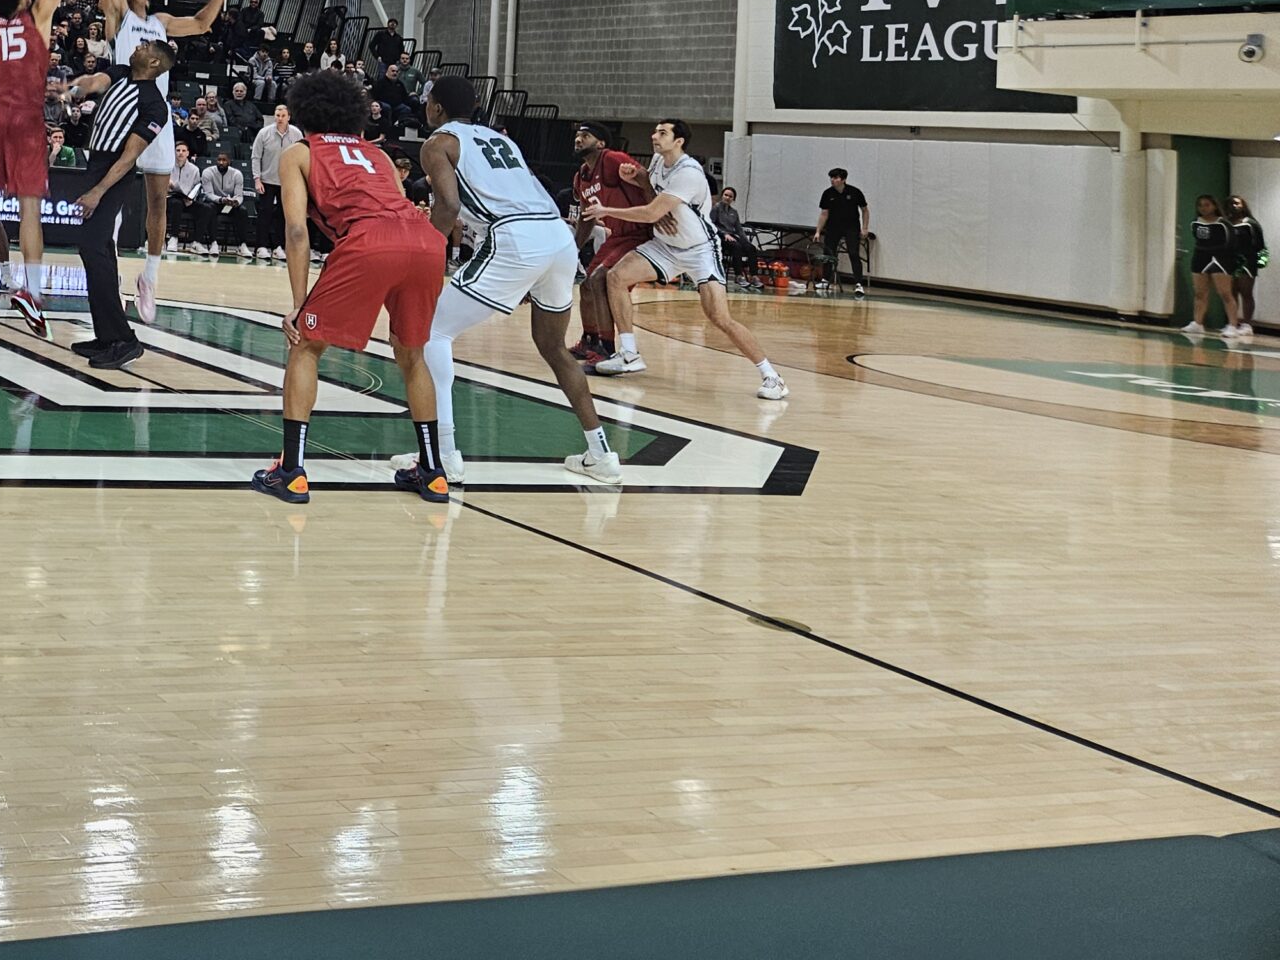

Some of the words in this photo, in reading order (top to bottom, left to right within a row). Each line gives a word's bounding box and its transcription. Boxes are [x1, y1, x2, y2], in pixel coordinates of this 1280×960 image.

[860, 20, 998, 62] LEAGU
[339, 144, 376, 174] 4
[473, 137, 522, 170] 22
